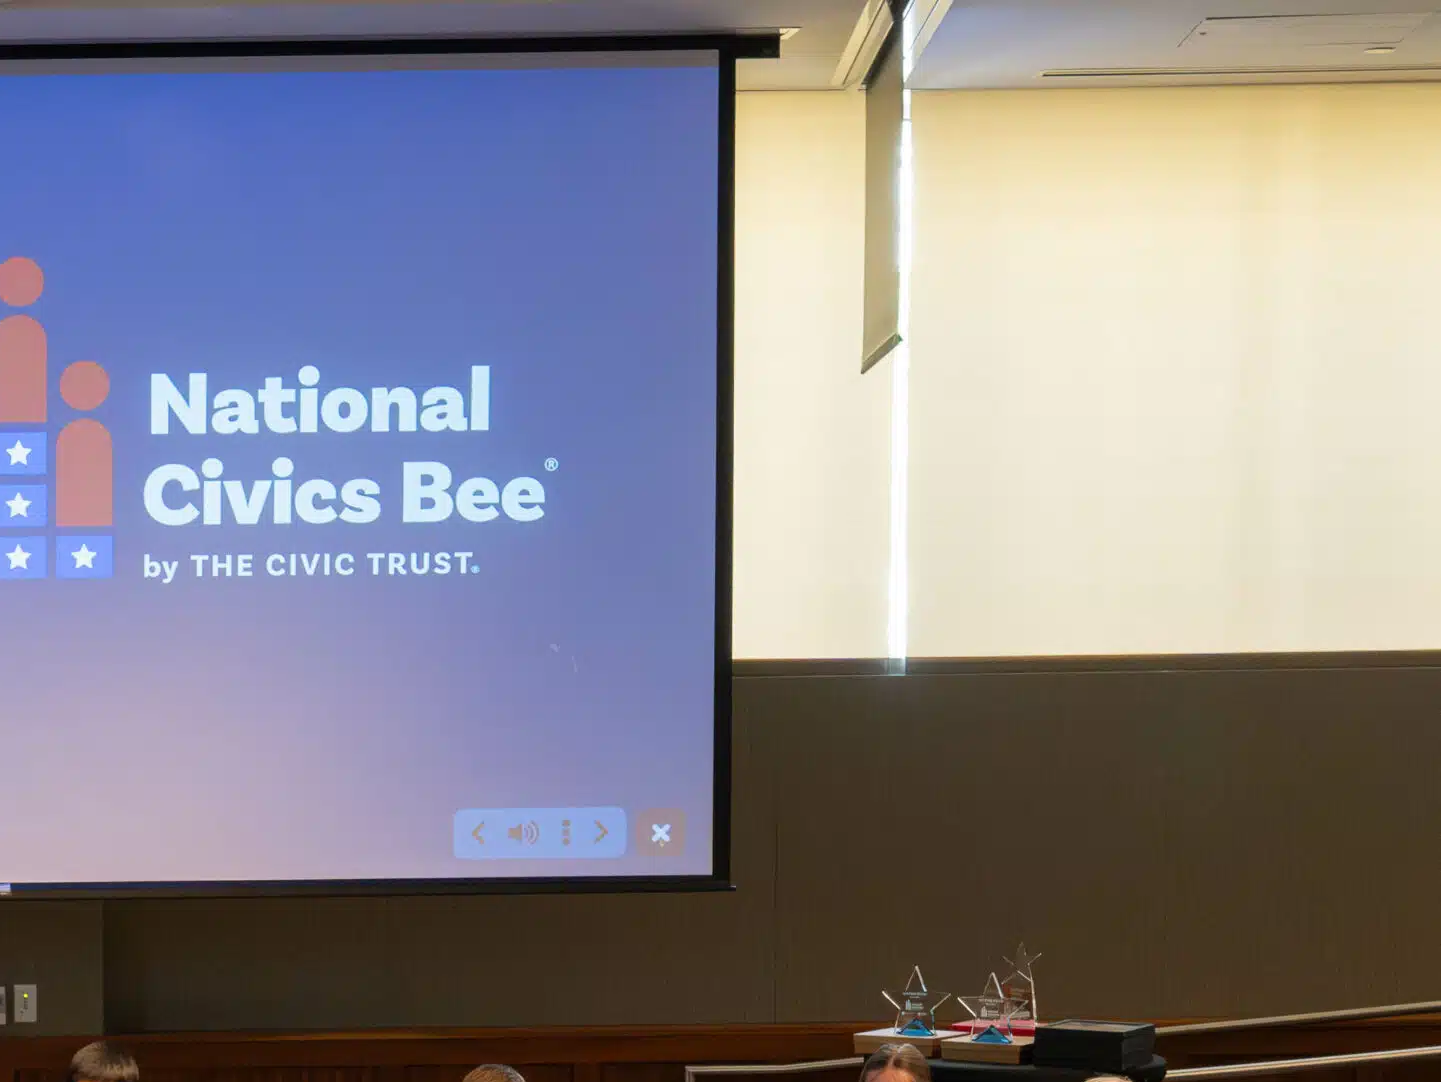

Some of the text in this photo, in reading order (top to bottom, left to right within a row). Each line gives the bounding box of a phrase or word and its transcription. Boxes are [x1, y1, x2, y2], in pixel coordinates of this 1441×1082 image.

[149, 365, 490, 435] National
[143, 457, 381, 526] Civics
[143, 554, 179, 583] by
[190, 554, 253, 577] THE
[266, 553, 355, 576] CIVIC
